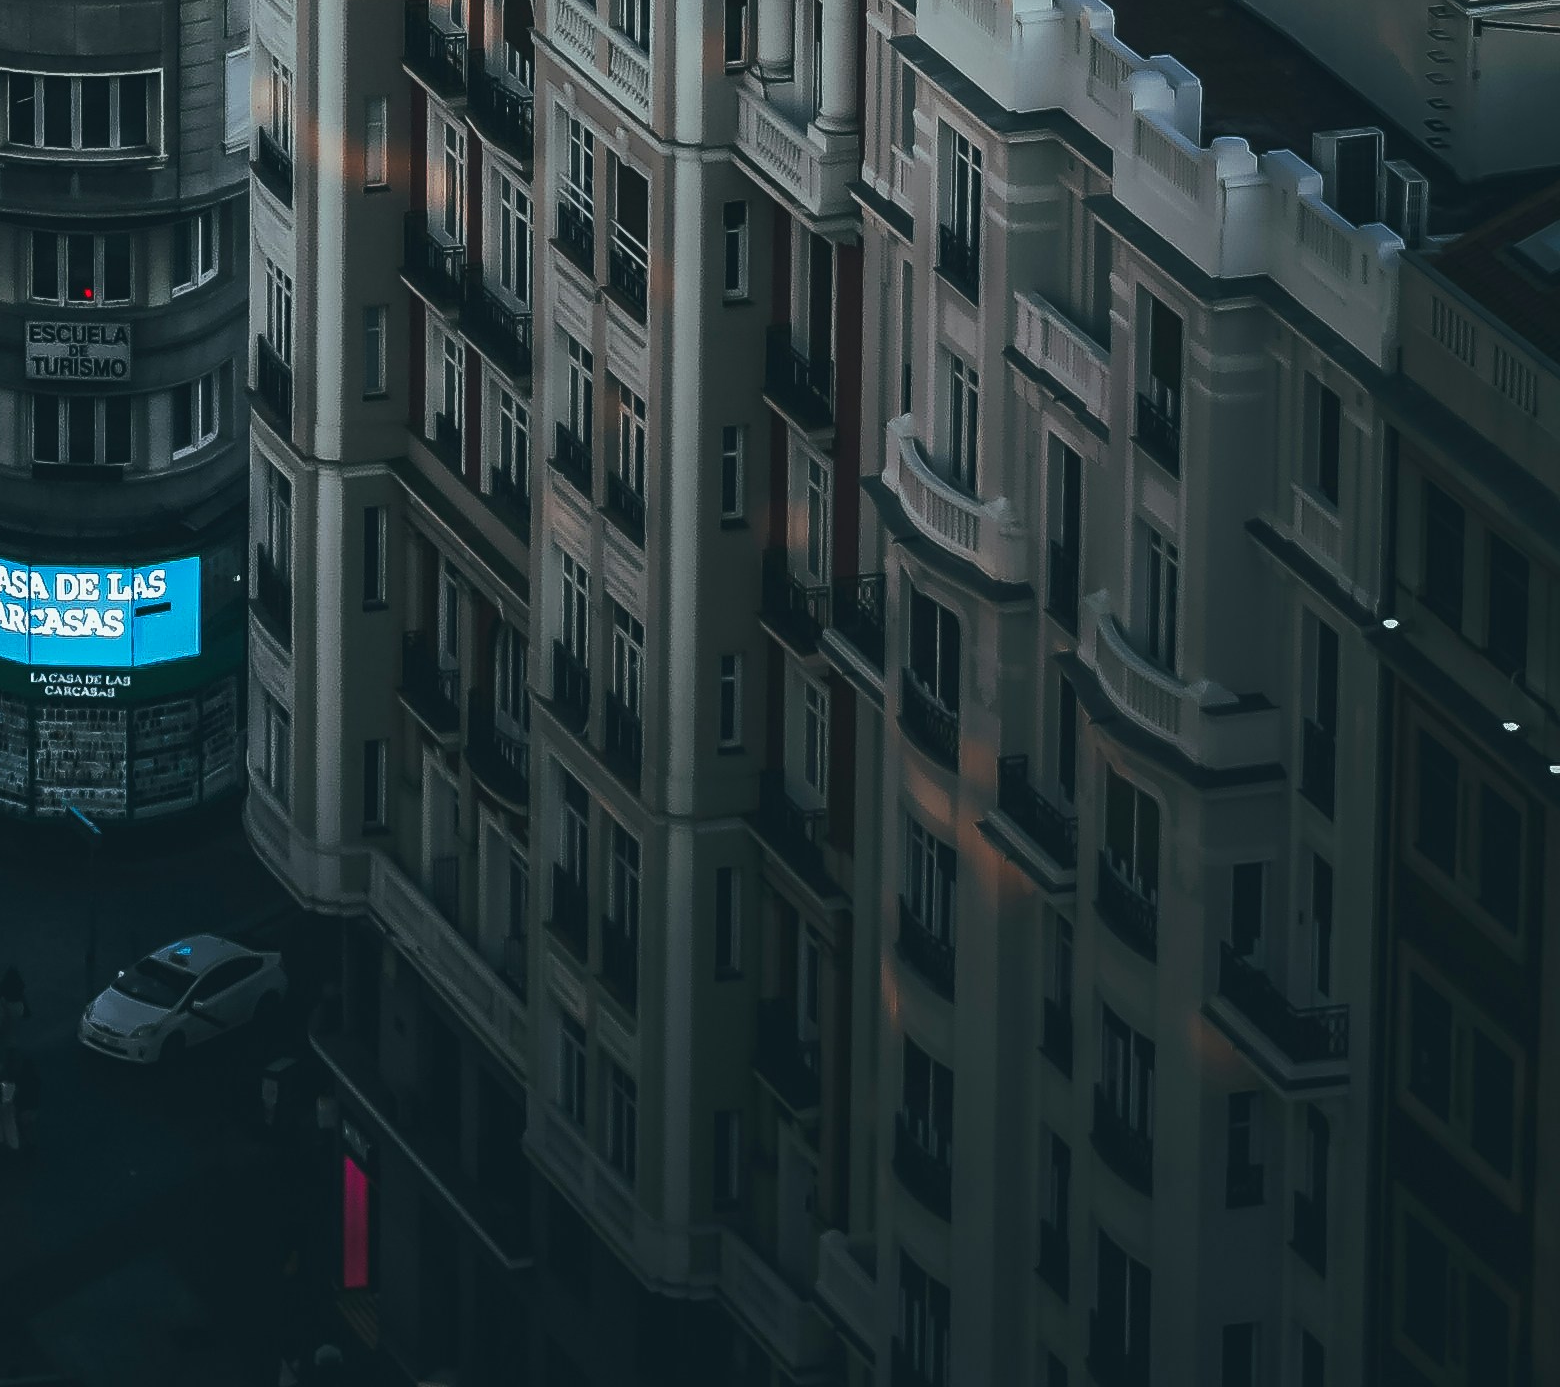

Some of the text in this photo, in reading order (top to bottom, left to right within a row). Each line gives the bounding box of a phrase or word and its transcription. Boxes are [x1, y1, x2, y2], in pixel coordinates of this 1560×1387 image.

[28, 325, 130, 344] ESCUELA
[68, 344, 89, 357] DE
[30, 357, 128, 378] TURISMO
[55, 572, 100, 602] DE
[106, 569, 167, 601] LAS
[30, 672, 131, 687] LA CASA DE LAS
[44, 685, 115, 698] CARCASAS
